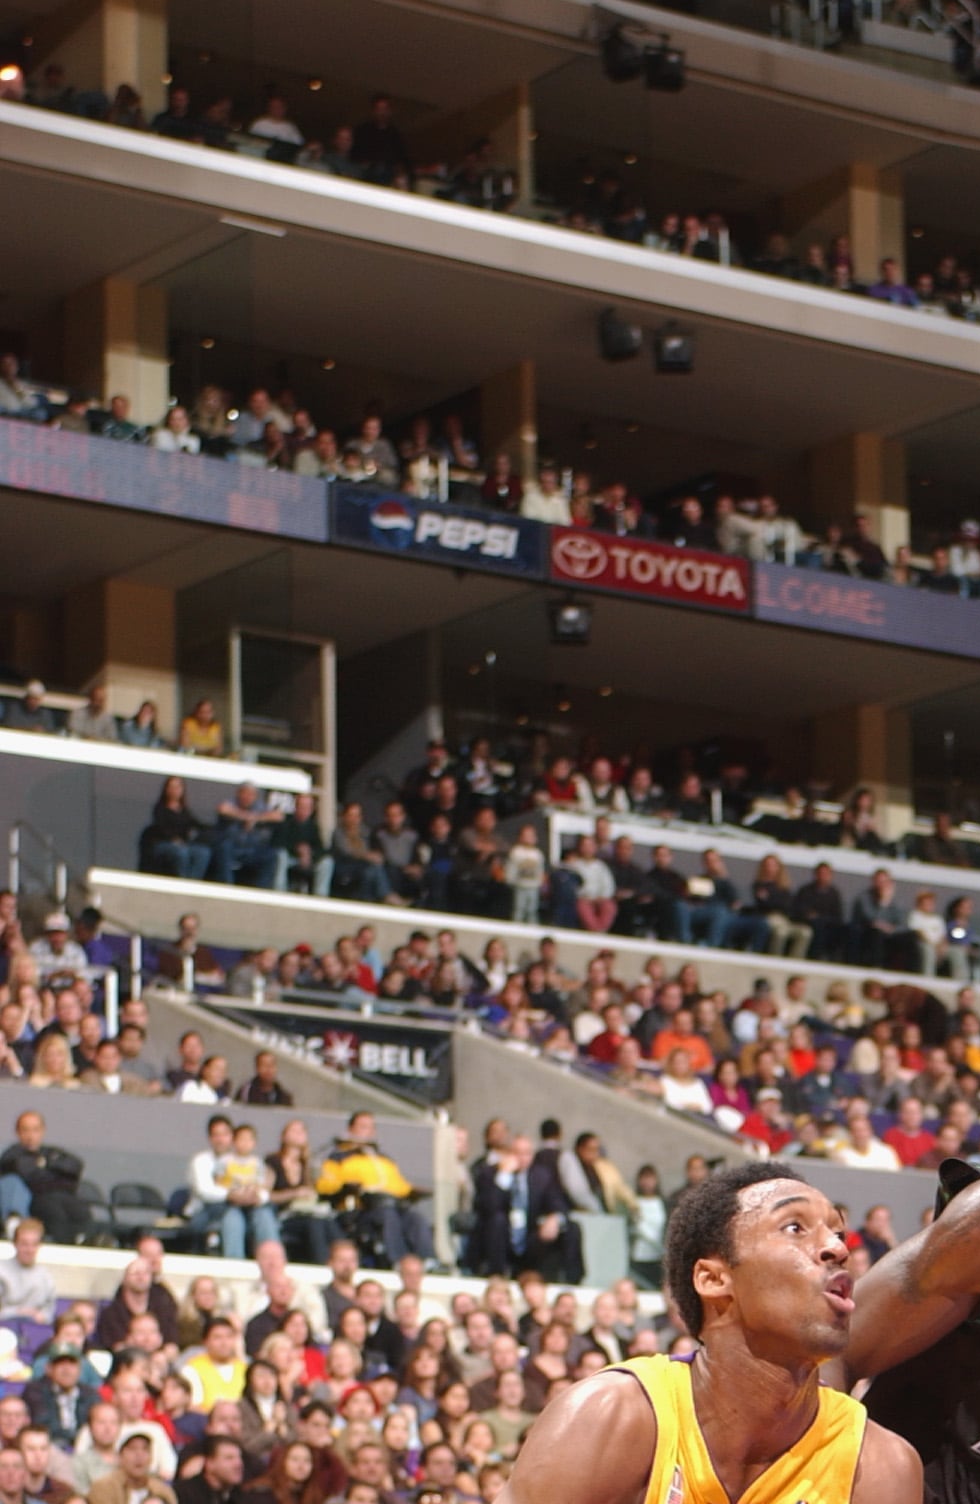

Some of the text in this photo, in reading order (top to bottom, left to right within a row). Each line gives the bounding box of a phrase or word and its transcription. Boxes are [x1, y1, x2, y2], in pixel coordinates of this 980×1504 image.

[415, 511, 519, 560] PEPSI
[609, 546, 746, 600] TOYOTA
[360, 1041, 432, 1078] BELL
